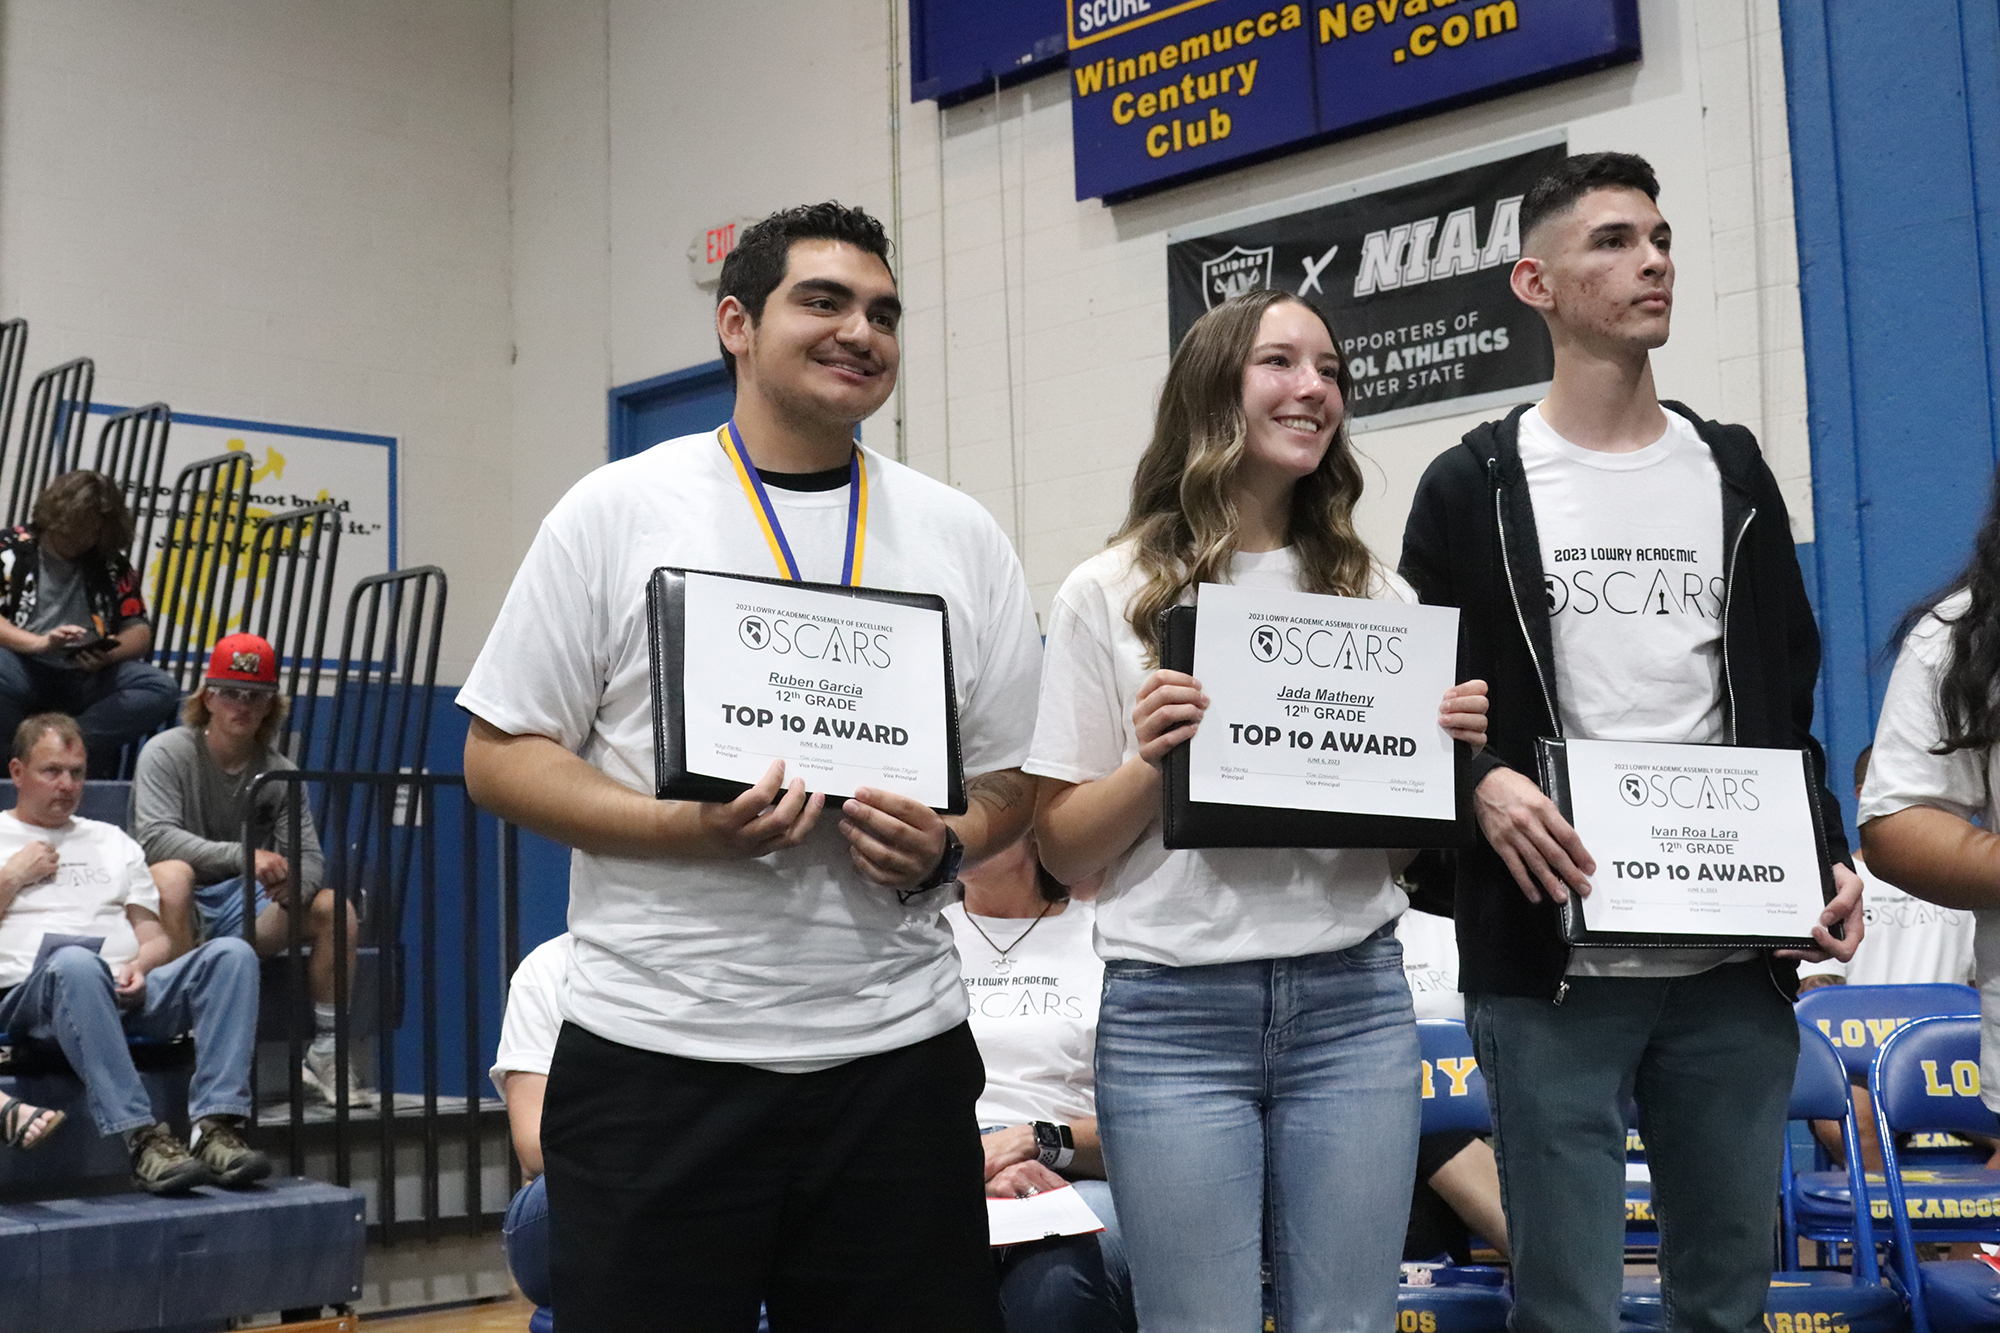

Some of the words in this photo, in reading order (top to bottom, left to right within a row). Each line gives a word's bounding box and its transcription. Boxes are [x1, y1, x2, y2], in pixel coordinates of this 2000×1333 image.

[1393, 0, 1518, 63] .com
[1074, 4, 1302, 97] Winnemucca
[1112, 59, 1259, 125] Century
[1146, 108, 1232, 158] Club
[706, 223, 736, 264] EXIT
[1353, 194, 1525, 298] NIAA
[1211, 254, 1263, 276] RAIDERS
[1341, 320, 1447, 355] PPORTERS
[1454, 311, 1479, 331] OF
[1385, 327, 1510, 374] ATHLETICS
[1351, 378, 1400, 401] LVER
[1407, 363, 1466, 390] STATE
[1554, 548, 1587, 562] 2023
[1591, 547, 1632, 562] LOWRY
[1637, 548, 1698, 563] ACADEMIC
[1544, 568, 1725, 620] OSCARS
[736, 603, 752, 612] 2023
[753, 606, 776, 615] LOWRY
[777, 610, 811, 621] ACADEMIC
[811, 615, 845, 626] ASSEMBLY
[855, 622, 893, 633] EXCELLENCE
[1248, 613, 1265, 621] 2023
[1265, 614, 1289, 623] LOWRY
[1290, 617, 1324, 627] ACADEMIC
[1325, 620, 1359, 630] ASSEMBLY
[1359, 623, 1369, 631] OF
[1369, 624, 1408, 635] EXCELLENCE
[738, 615, 891, 669] OSCARS
[1250, 624, 1404, 674] OSCARS
[769, 672, 814, 689] Ruben
[818, 679, 863, 696] Garcia
[775, 690, 801, 703] 12th
[805, 694, 857, 711] GRADE
[1277, 685, 1311, 700] Jada
[1315, 688, 1375, 707] Matheny
[721, 704, 774, 728] TOP
[780, 714, 806, 733] 10
[812, 716, 909, 747] AWARD
[1284, 704, 1310, 717] 12th
[1314, 707, 1366, 722] GRADE
[1229, 723, 1282, 746] TOP
[1288, 729, 1314, 749] 10
[1320, 730, 1417, 757] AWARD
[1651, 765, 1682, 773] ACADEMIC
[1683, 766, 1714, 774] ASSEMBLY
[1723, 768, 1759, 776] EXCELLENCE
[1619, 773, 1760, 811] OSCARS
[1651, 826, 1678, 837] Ivan
[1682, 827, 1707, 838] Roa
[1711, 828, 1738, 839] Lara
[1659, 842, 1682, 853] 12th
[1686, 843, 1735, 855] GRADE
[1612, 861, 1660, 879] TOP
[1666, 864, 1690, 881] 10
[1697, 863, 1785, 883] AWARD
[977, 977, 1010, 987] LOWRY
[1012, 976, 1059, 987] ACADEMIC
